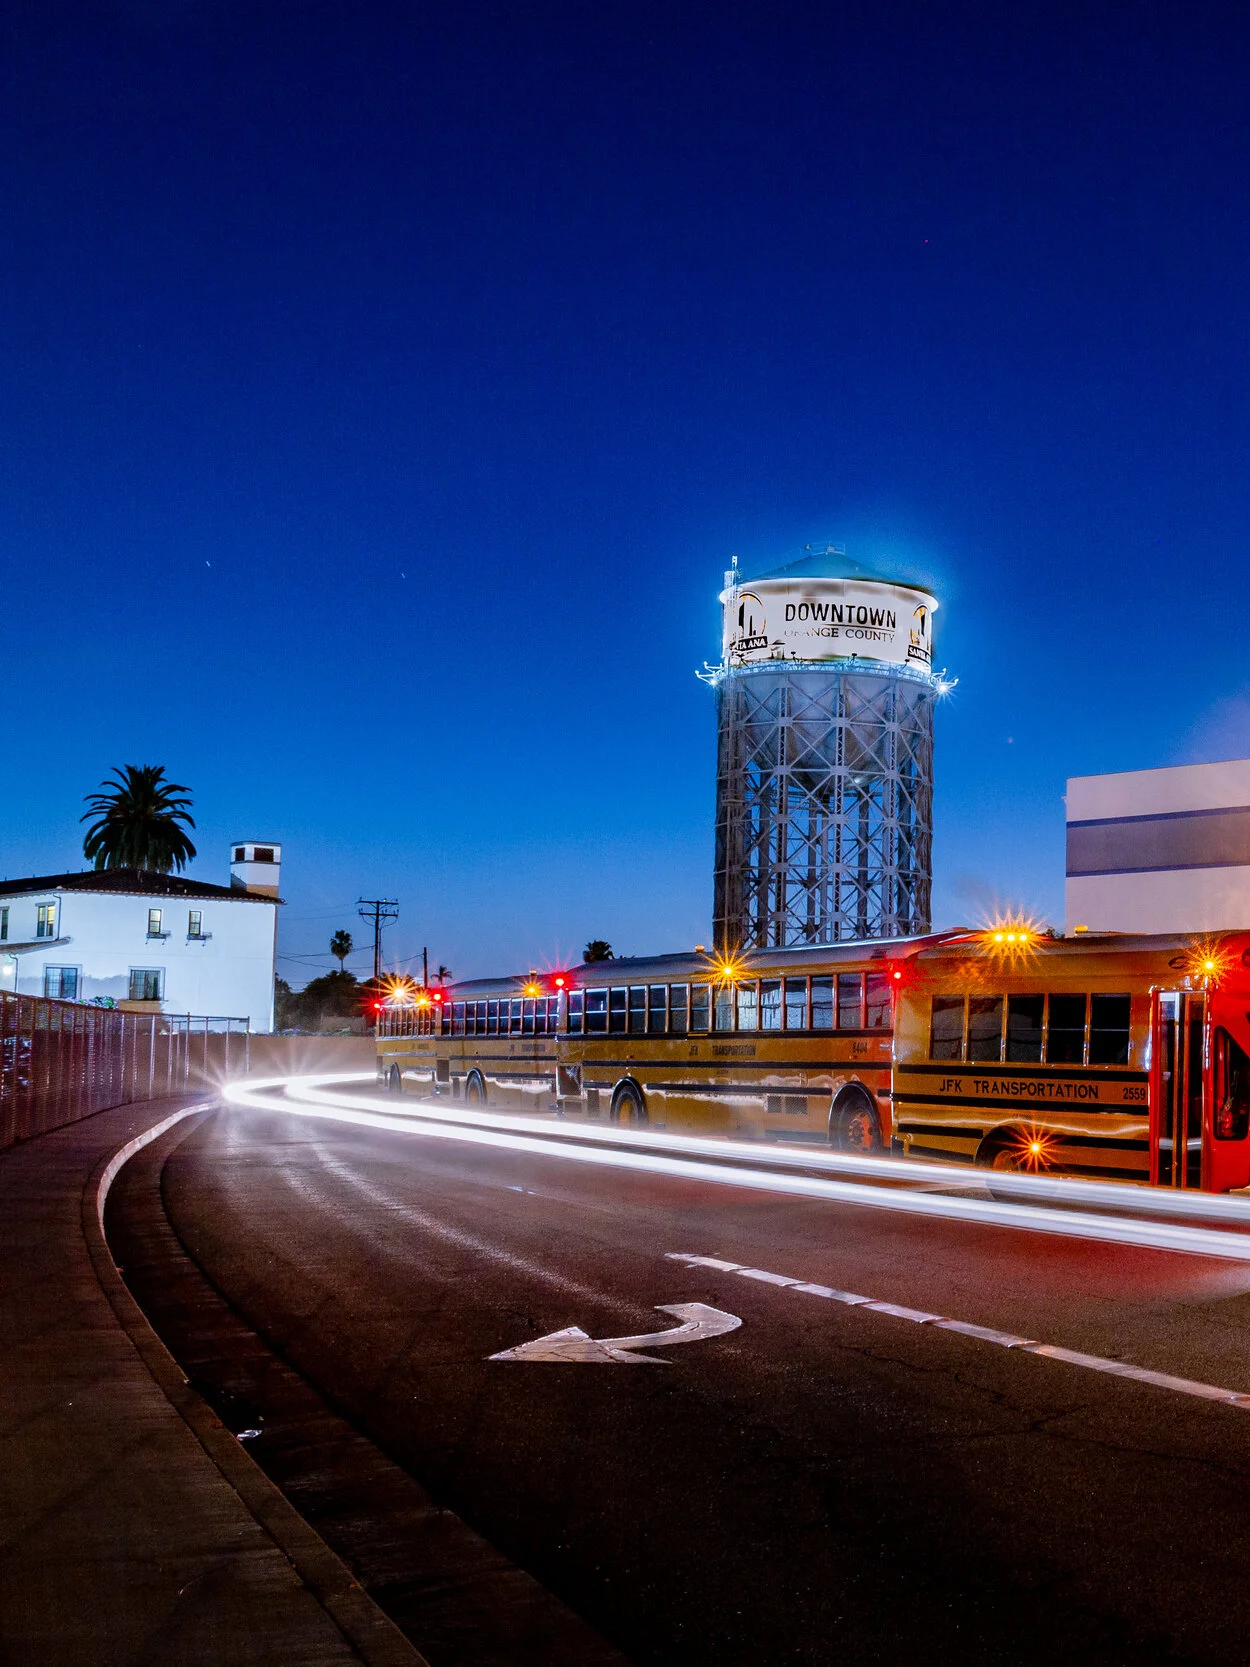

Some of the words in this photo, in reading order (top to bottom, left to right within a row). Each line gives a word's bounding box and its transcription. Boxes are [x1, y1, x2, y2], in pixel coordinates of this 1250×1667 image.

[785, 603, 896, 628] DOWNTOWN
[748, 637, 767, 649] ANA
[845, 628, 895, 643] COUNTY
[939, 1079, 963, 1093] JFK
[973, 1080, 1099, 1099] TRANSPORTATION
[1122, 1087, 1146, 1101] 2559
